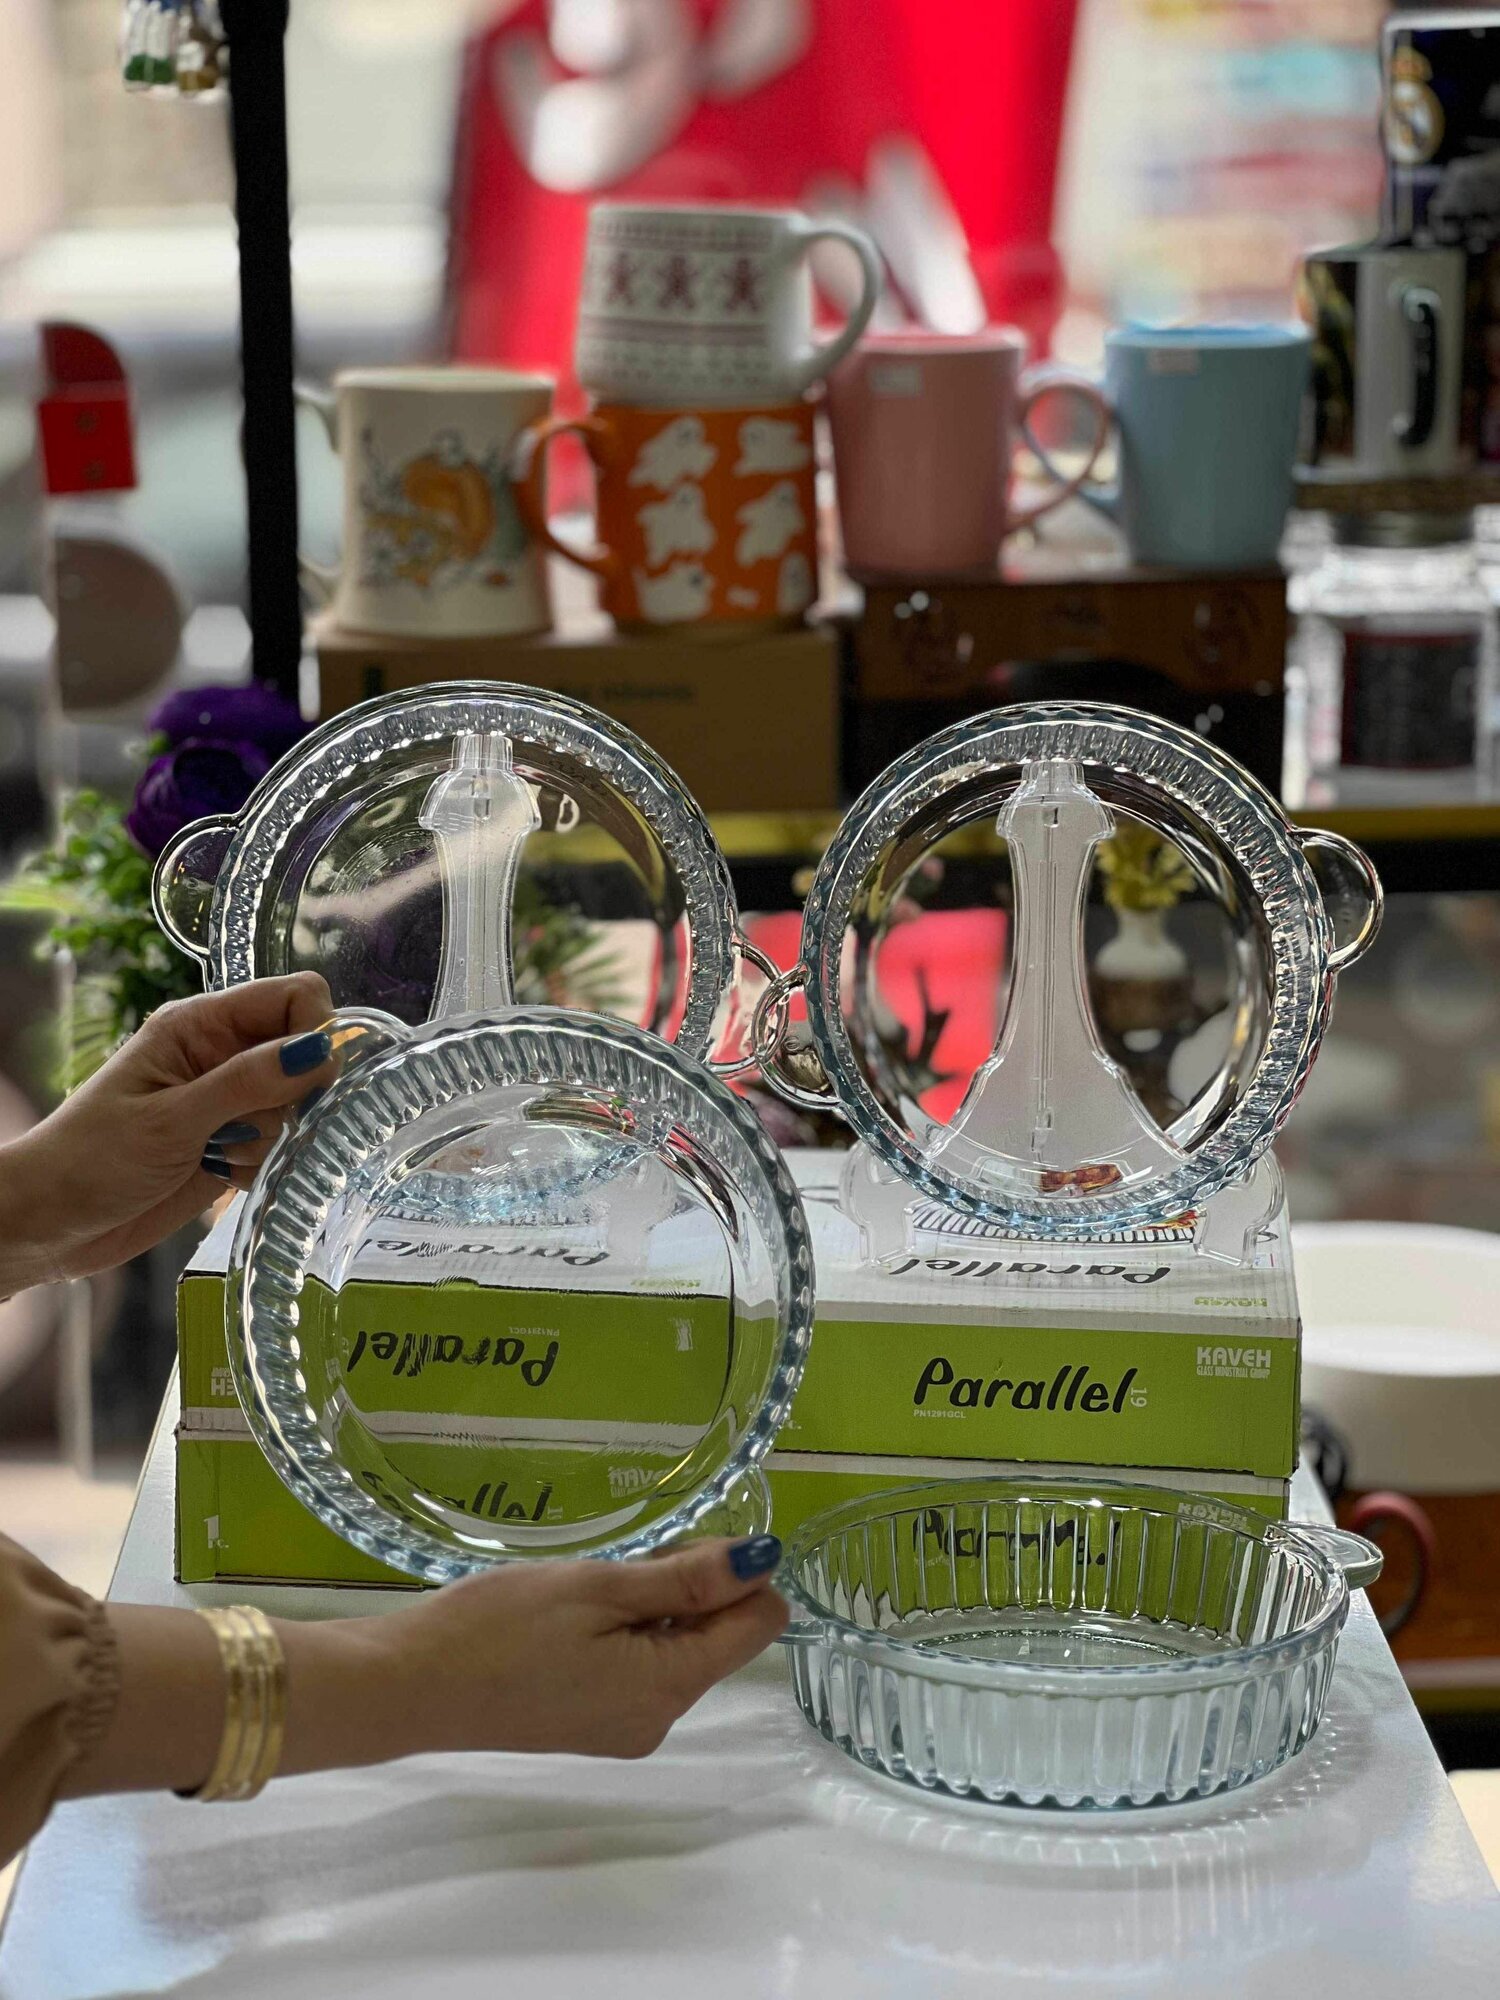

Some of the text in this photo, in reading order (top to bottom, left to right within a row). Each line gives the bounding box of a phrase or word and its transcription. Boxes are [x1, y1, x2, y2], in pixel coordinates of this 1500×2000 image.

[889, 1259, 1170, 1284] Parallel
[1197, 1346, 1271, 1368] KAVEH
[913, 1357, 1138, 1413] Parallel
[1130, 1387, 1147, 1407] 19
